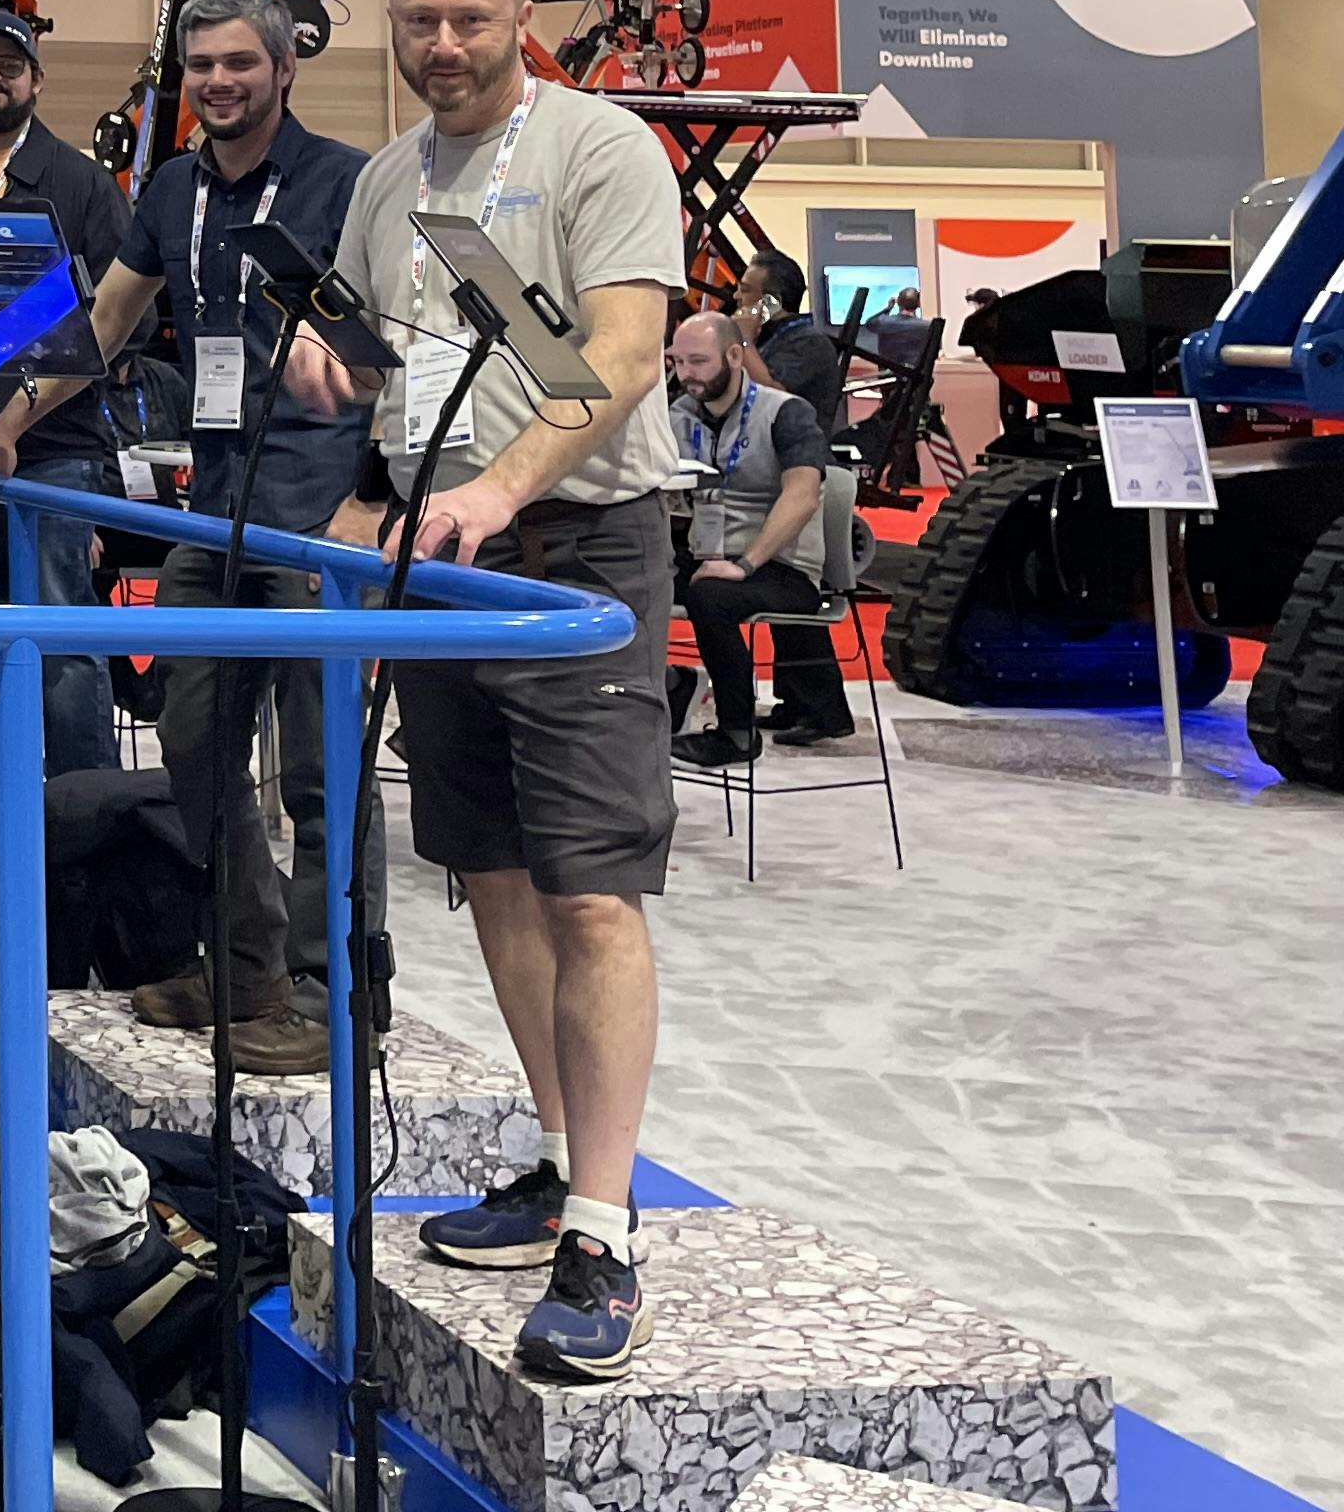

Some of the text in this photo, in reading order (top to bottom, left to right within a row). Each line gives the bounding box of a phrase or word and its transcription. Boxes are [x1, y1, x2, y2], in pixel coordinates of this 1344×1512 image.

[735, 15, 784, 33] Platform
[878, 5, 999, 25] Together, We
[750, 39, 763, 53] to
[879, 28, 1009, 47] Will Eliminate
[879, 50, 975, 69] Downtime
[1068, 352, 1109, 366] LOADER
